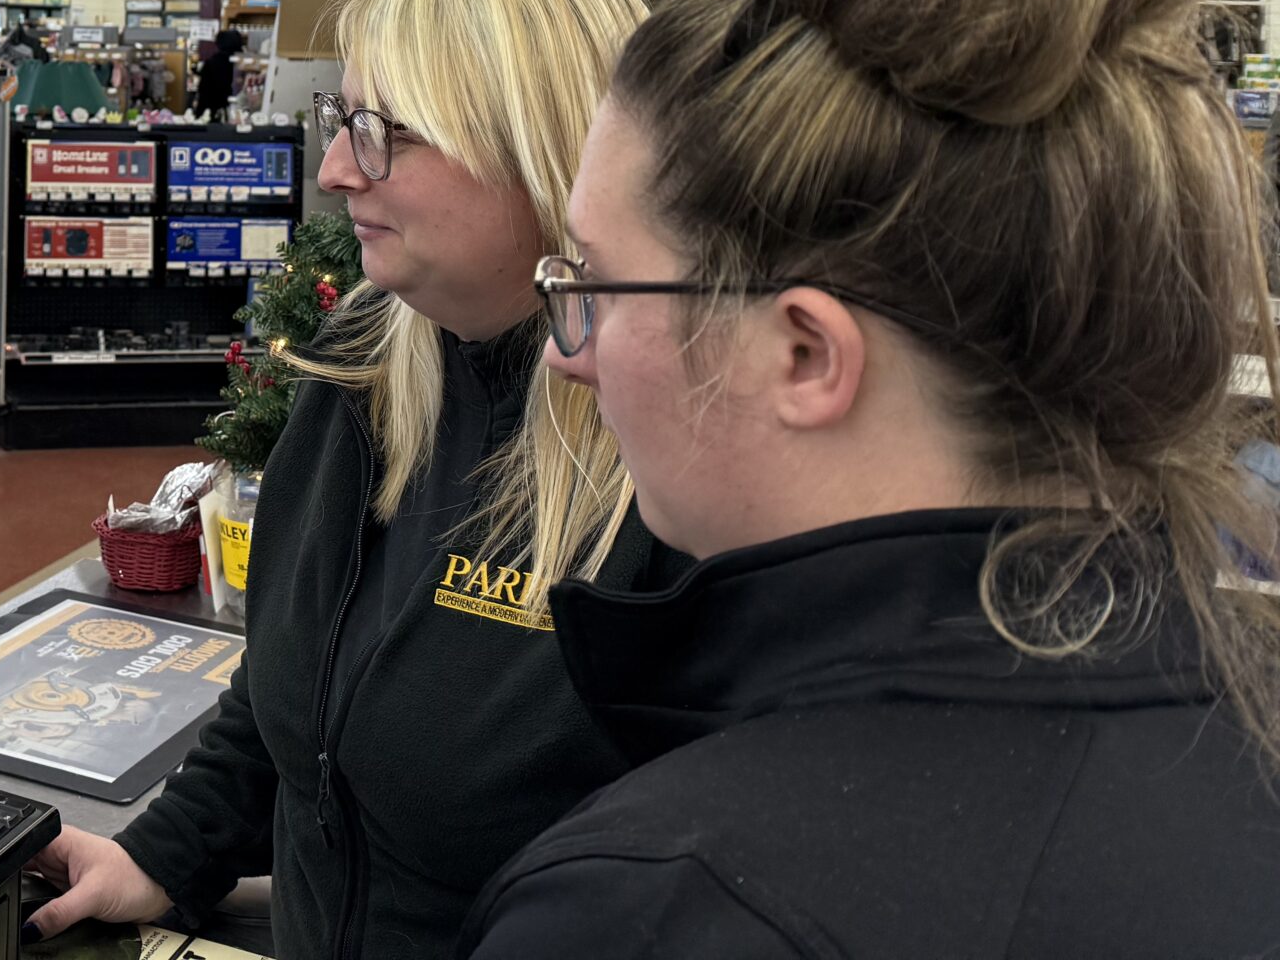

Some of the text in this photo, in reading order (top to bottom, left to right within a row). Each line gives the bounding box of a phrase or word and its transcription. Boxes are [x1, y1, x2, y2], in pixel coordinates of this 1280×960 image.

[194, 147, 232, 166] QO
[436, 591, 480, 613] EXPERIENCE
[488, 606, 518, 623] MODERN
[147, 634, 193, 656] COOL
[169, 638, 232, 673] SMOOTH
[116, 655, 162, 679] CUTS
